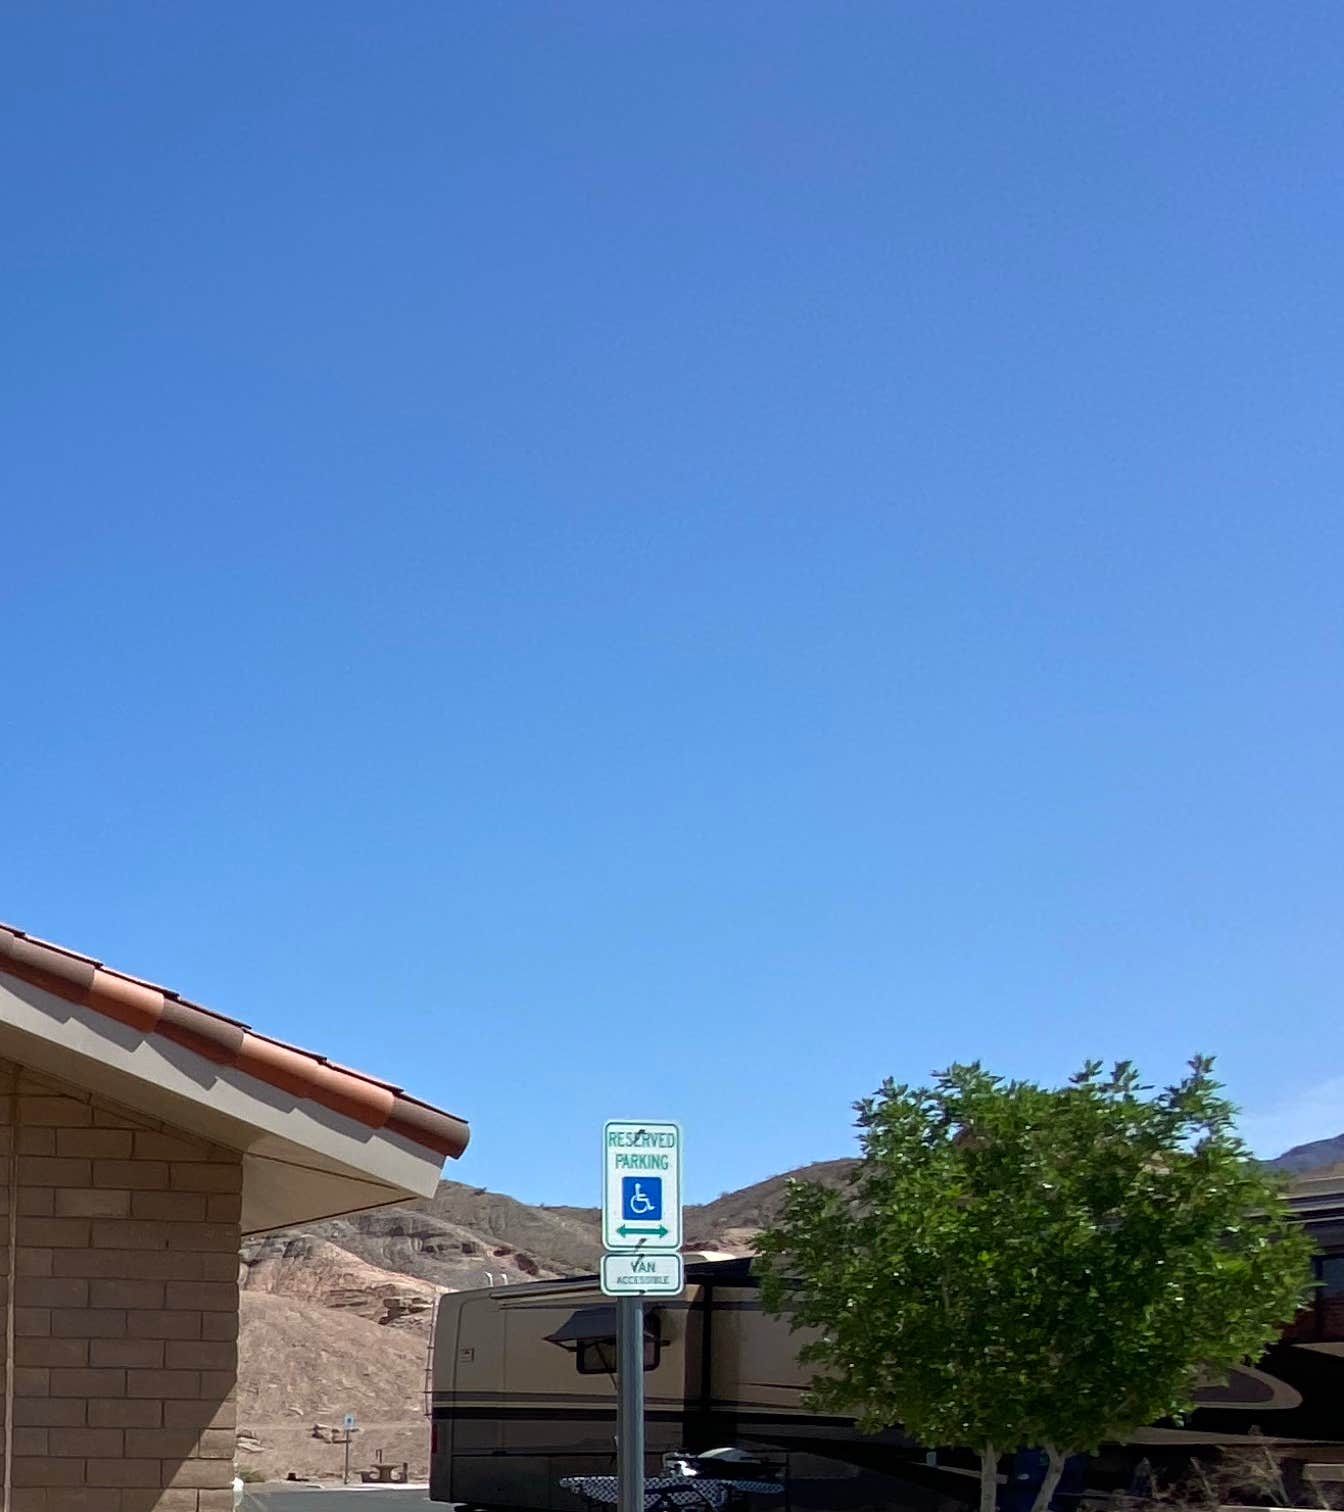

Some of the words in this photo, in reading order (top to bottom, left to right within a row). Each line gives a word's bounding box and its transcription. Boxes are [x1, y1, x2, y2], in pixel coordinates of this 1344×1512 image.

[609, 1131, 675, 1148] RESERVED
[616, 1154, 669, 1170] PARKING
[630, 1261, 656, 1273] VAN
